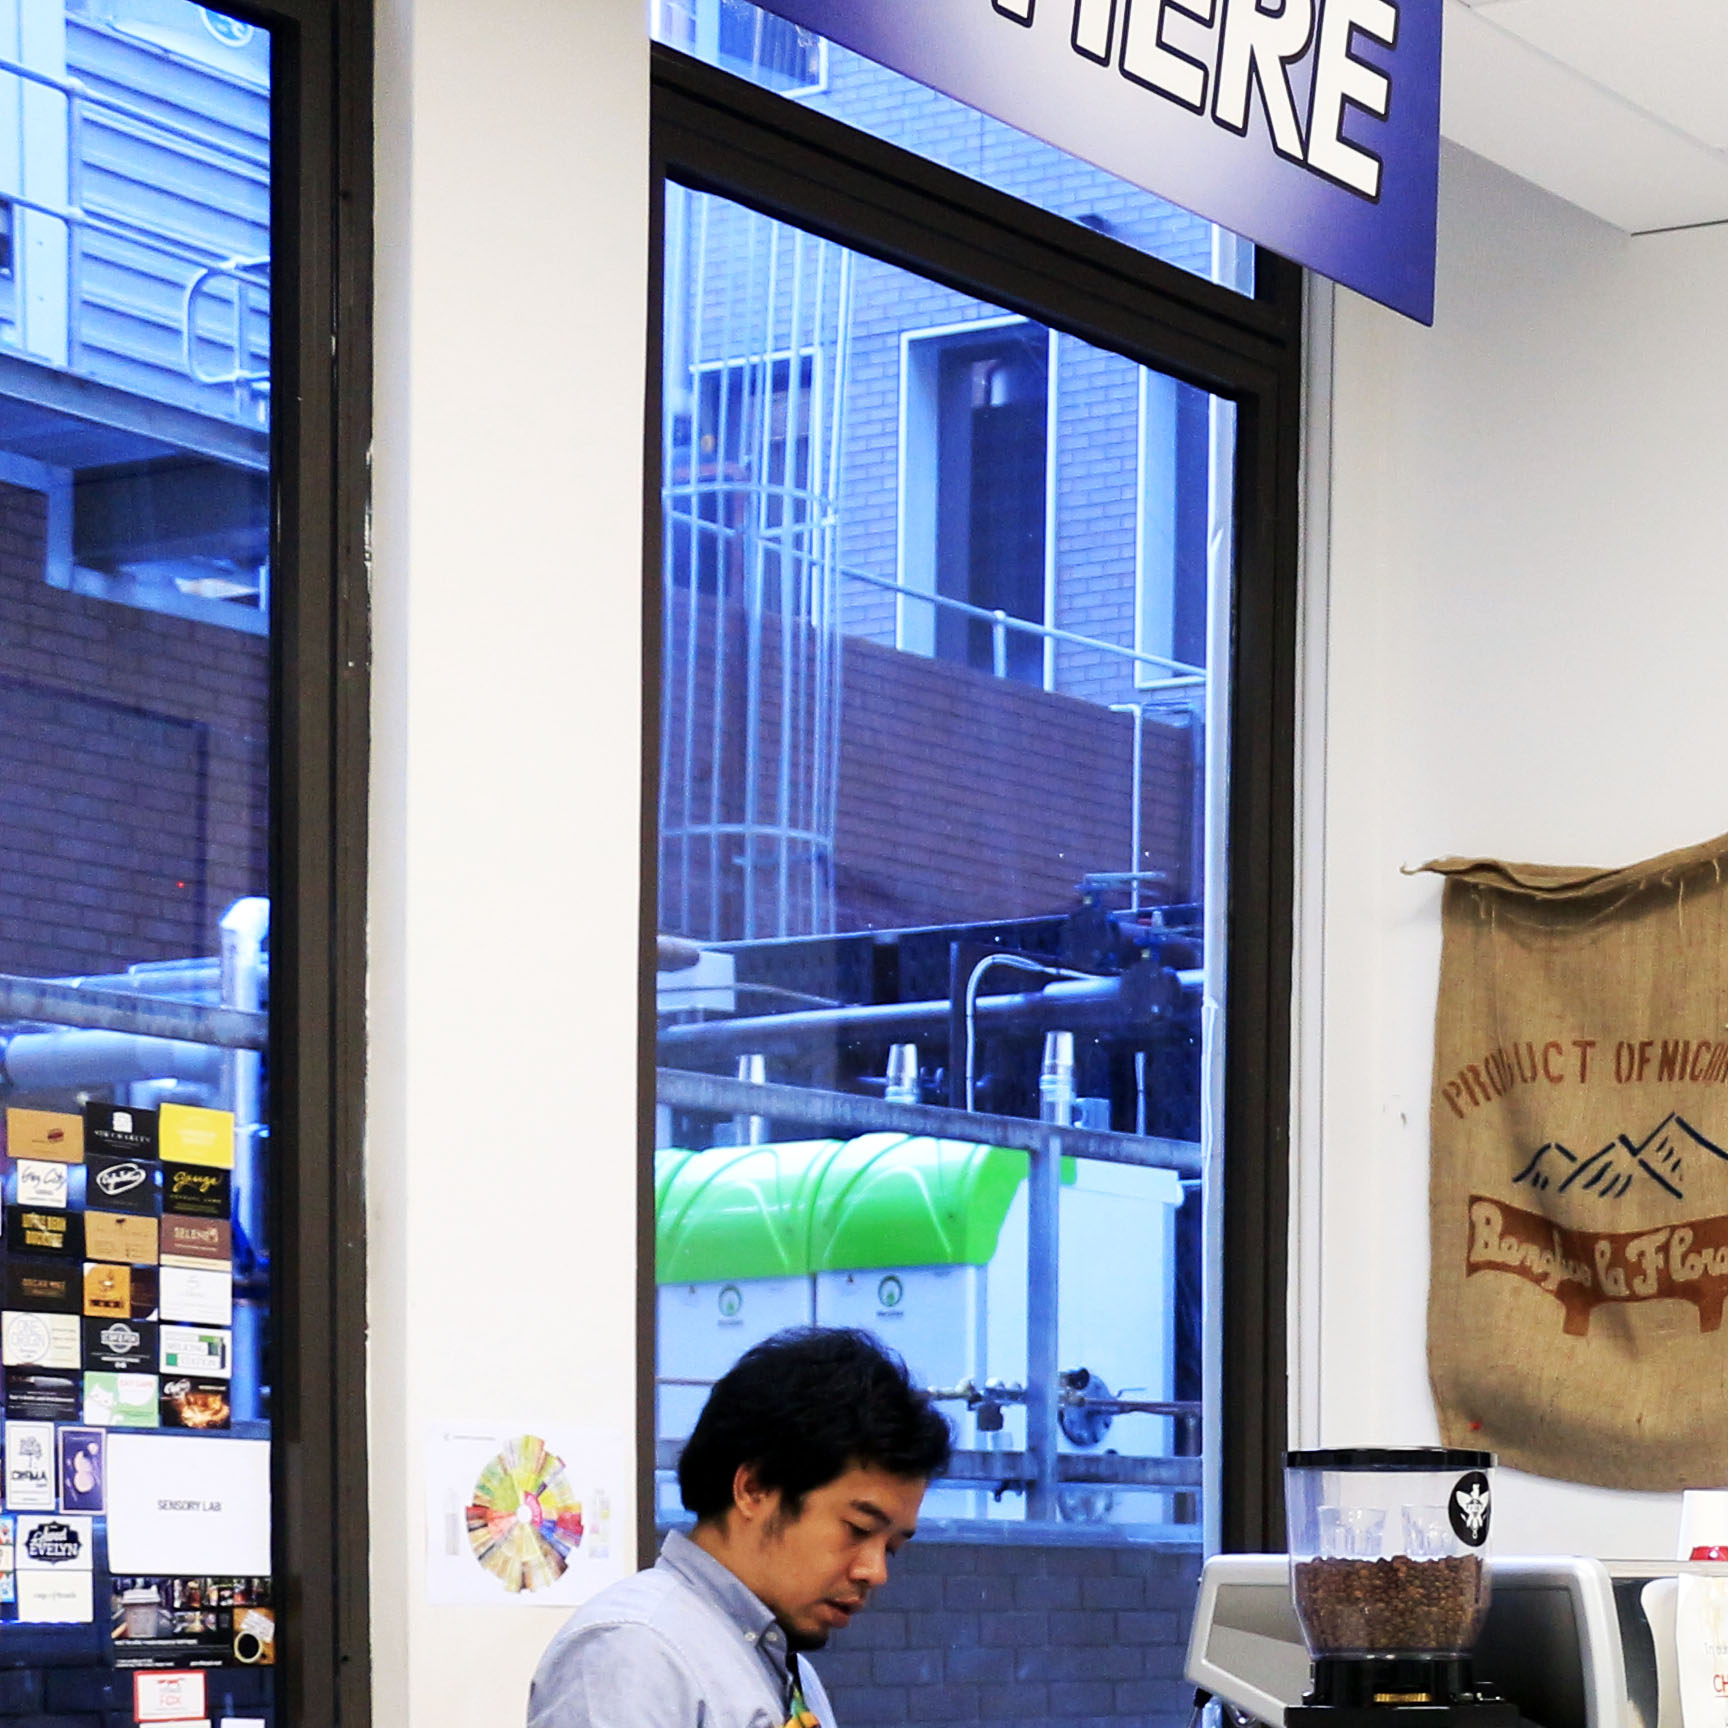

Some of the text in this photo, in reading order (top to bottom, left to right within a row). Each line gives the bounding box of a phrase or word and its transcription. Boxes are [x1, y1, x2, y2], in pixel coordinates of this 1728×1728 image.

[992, 0, 1399, 203] ERE
[1441, 1039, 1597, 1119] PRODUCT
[1614, 1039, 1654, 1083] OF
